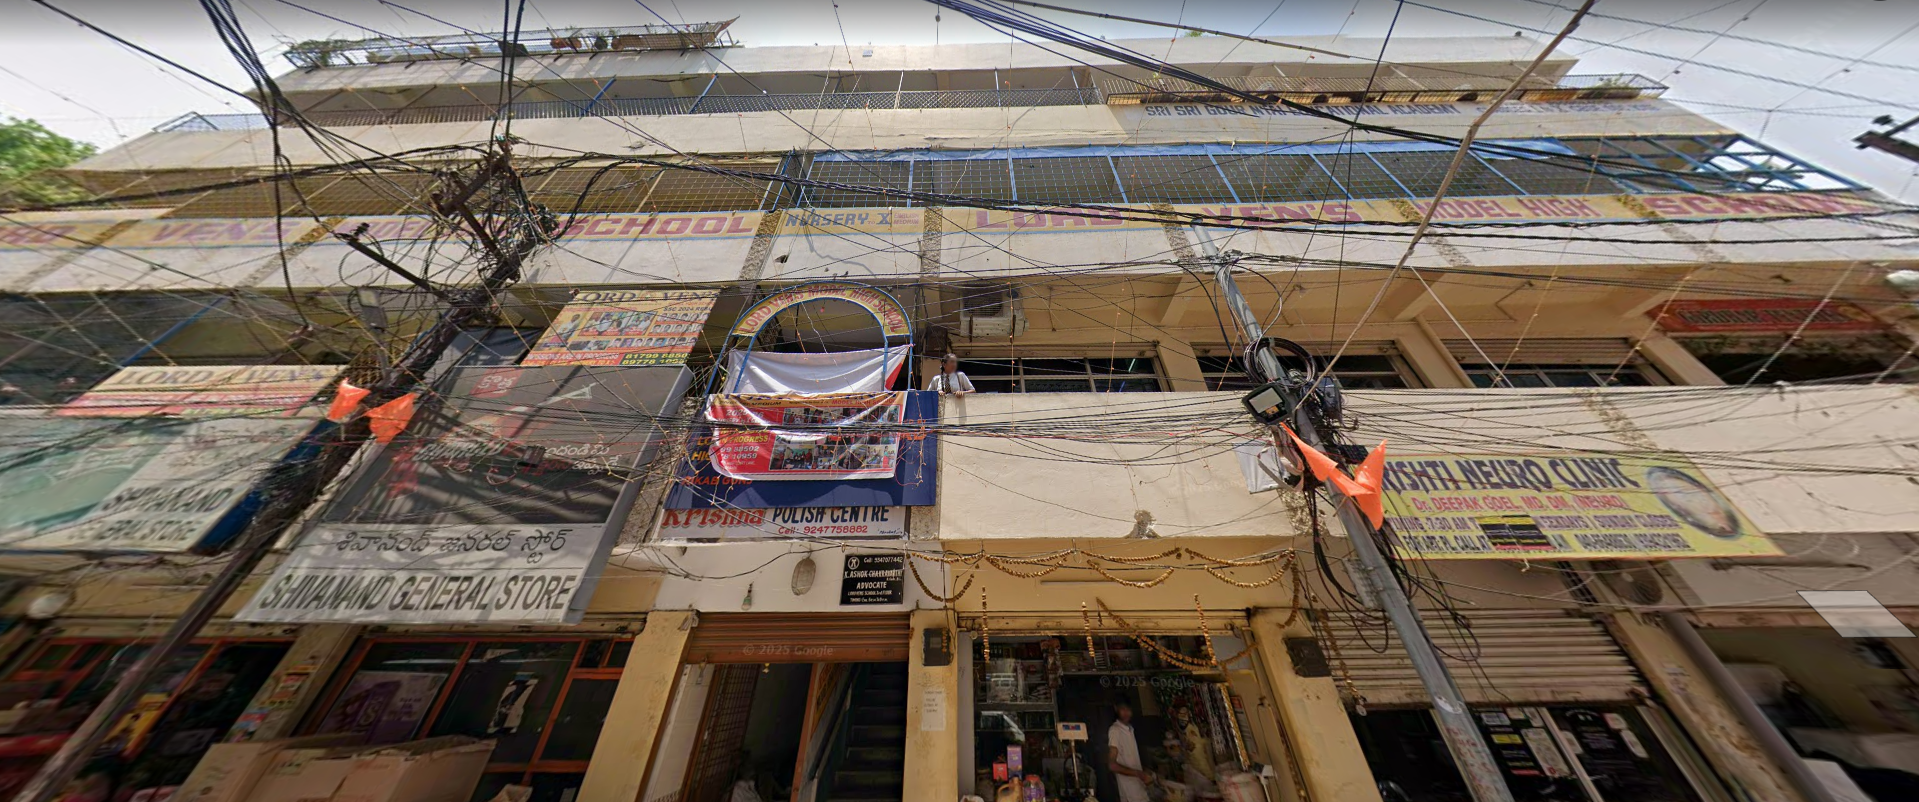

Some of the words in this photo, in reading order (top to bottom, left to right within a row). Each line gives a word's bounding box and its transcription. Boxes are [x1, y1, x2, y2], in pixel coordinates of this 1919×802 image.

[1145, 105, 1172, 117] SRI
[1173, 105, 1202, 116] SRI
[1388, 104, 1461, 115] ACADEMY
[785, 212, 870, 227] NURSERY
[1202, 203, 1366, 225] VEN'S
[1413, 200, 1524, 219] MODEL
[1514, 199, 1602, 217] HIGH
[551, 216, 755, 236] SCHOOL
[578, 291, 637, 303] ORD
[739, 305, 772, 333] LORD
[806, 284, 846, 298] MODEL
[850, 287, 880, 305] HIGH
[871, 300, 906, 333] SCHOOL
[1455, 459, 1553, 492] NEURO
[1548, 458, 1642, 488] CLINIC
[1411, 497, 1432, 511] Dr.
[1430, 497, 1483, 511] DEEPAK
[771, 506, 826, 524] POLISH
[829, 506, 890, 523] CENTRE
[803, 525, 868, 535] 9247758882
[258, 576, 397, 611] SHIVANAND
[388, 575, 496, 611] GENERAL
[494, 575, 577, 611] STORE
[856, 581, 887, 589] ADVOCATE
